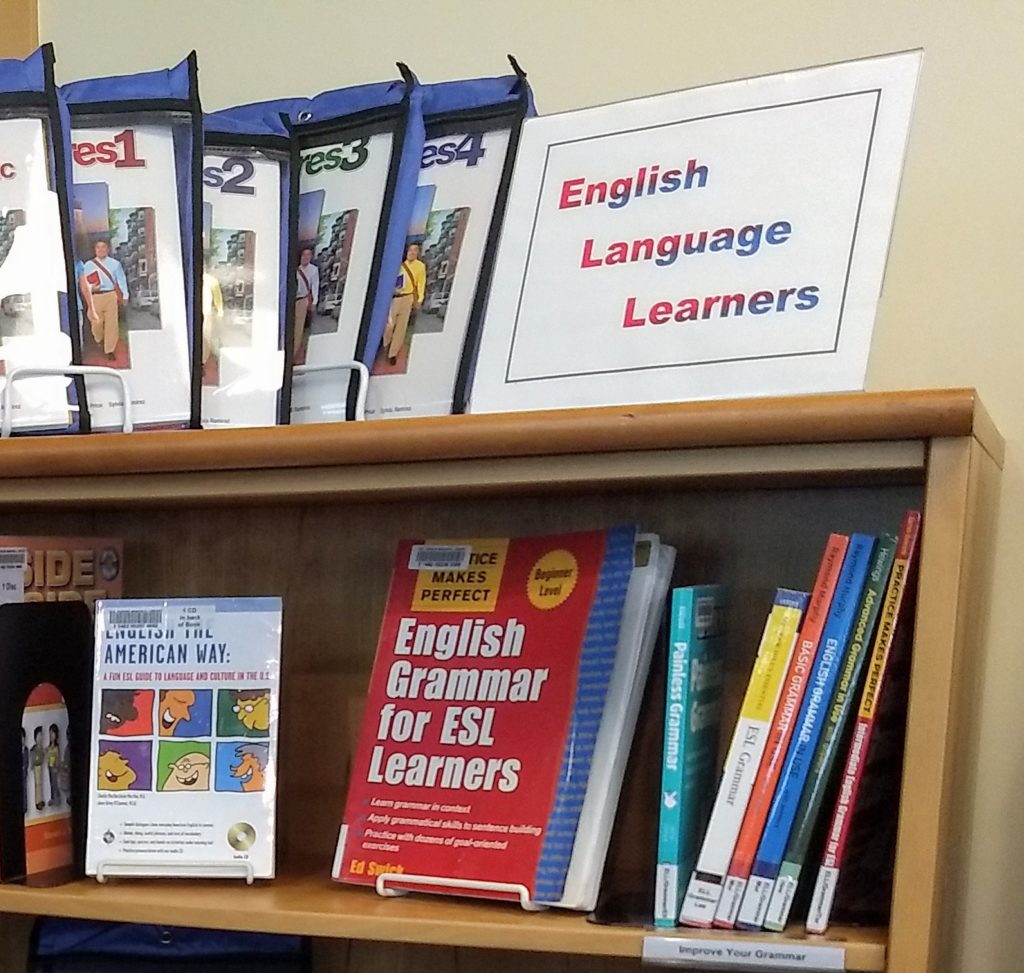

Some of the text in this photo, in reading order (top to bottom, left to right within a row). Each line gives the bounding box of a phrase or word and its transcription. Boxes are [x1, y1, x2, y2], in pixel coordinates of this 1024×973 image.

[558, 158, 709, 210] English
[580, 220, 792, 268] Language
[622, 285, 821, 329] Learners
[420, 588, 491, 601] PERFECT
[431, 571, 487, 584] MAKES
[534, 567, 573, 582] Beginner
[538, 584, 562, 597] Level
[104, 643, 230, 664] AMERICAN WAY:
[393, 617, 526, 661] English
[840, 588, 877, 690] Advanced Grammar
[863, 564, 905, 713] PRACTICE MAKES PERFECT
[109, 672, 236, 681] FUN ESL GUIDE TO LANGUAGE AND CULTURE
[385, 660, 549, 702] Grammar
[777, 640, 813, 731] BASIC GRAMMAR
[800, 637, 838, 742] ENGLISH GRAMMAR
[376, 703, 497, 747] for ESL
[667, 642, 688, 771] Painless Grammar
[367, 745, 522, 793] Learners
[727, 726, 760, 806] ESL Grammar
[367, 813, 543, 836] Apply grammatical skills sentence building
[370, 798, 471, 813] Learn grammar in context
[362, 842, 400, 852] exercises
[364, 829, 508, 849] Practice with dozens of goal-oriented
[349, 859, 364, 874] Ed
[678, 945, 806, 961] Improve Your Grammar
